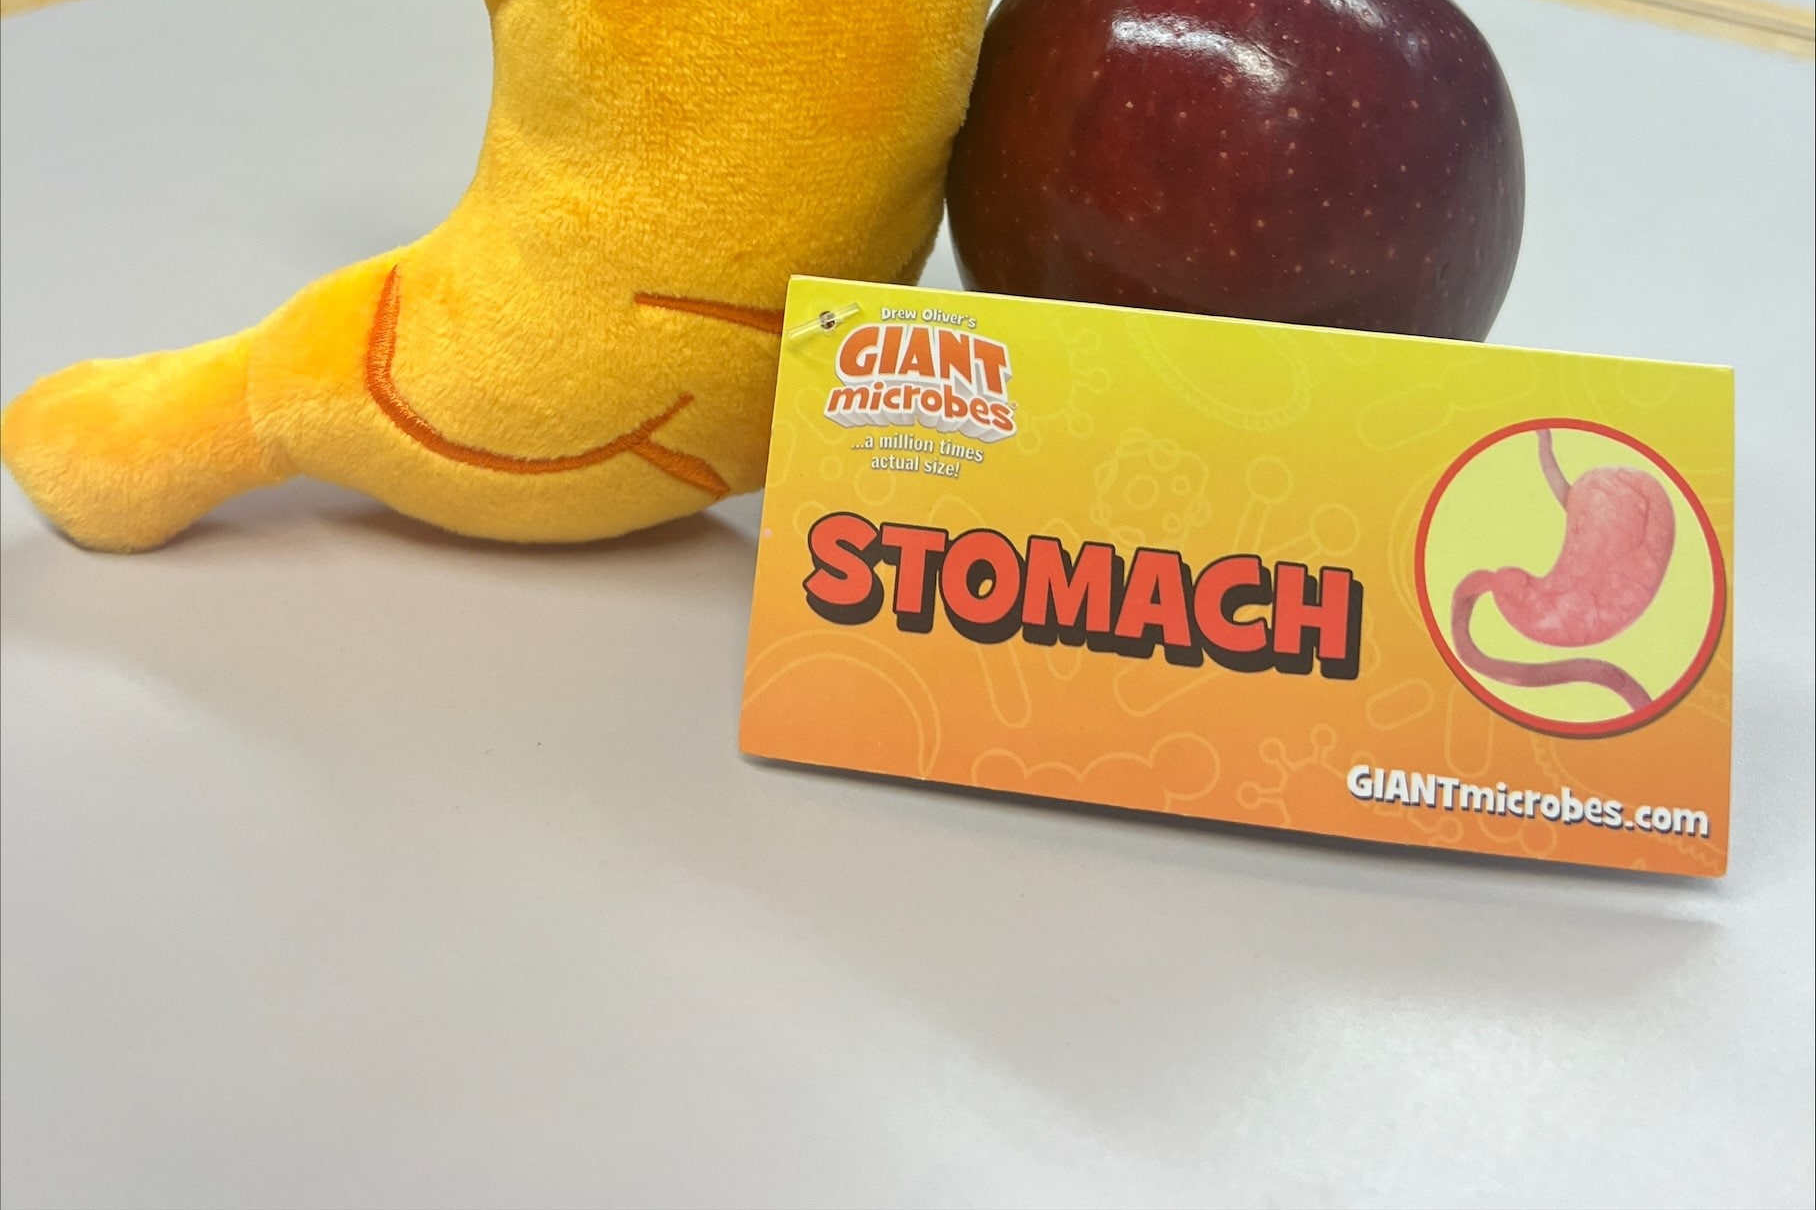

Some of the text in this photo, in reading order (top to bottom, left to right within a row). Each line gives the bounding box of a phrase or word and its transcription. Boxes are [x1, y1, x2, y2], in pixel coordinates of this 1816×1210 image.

[880, 306, 977, 329] Drew Oliver's
[837, 324, 1009, 396] GIANT
[826, 380, 1015, 435] microbes
[871, 452, 960, 478] actual size!
[879, 433, 935, 454] million
[938, 438, 984, 463] times
[803, 511, 1364, 680] STOMACH
[1345, 764, 1710, 838] GIANTmicrobes.com
